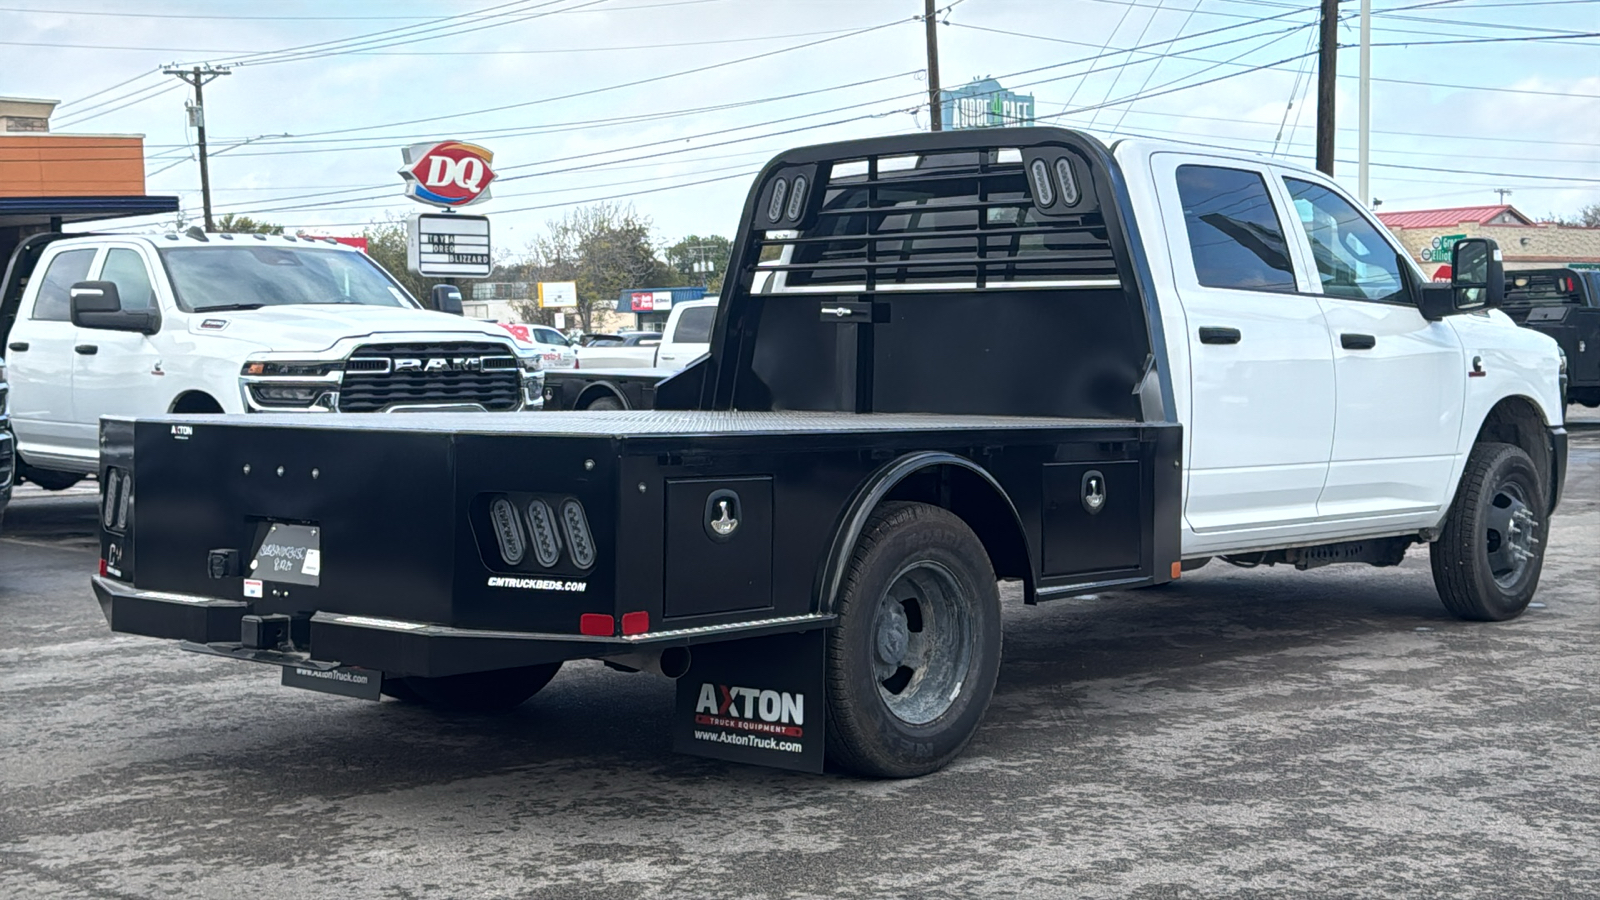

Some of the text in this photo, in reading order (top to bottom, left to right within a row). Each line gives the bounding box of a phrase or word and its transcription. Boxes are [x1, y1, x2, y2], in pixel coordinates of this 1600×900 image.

[425, 155, 484, 193] DQ
[428, 234, 444, 243] TRY
[433, 244, 455, 253] OREO
[449, 254, 489, 264] BLIZZARD
[394, 358, 480, 372] RAM
[170, 425, 193, 435] AXTON
[487, 576, 587, 592] CMTRUCKBEDS.COM
[695, 683, 804, 725] AXTON
[710, 717, 786, 733] TRUCK EQUIPMENT
[694, 730, 802, 752] www.AxtonTruck.com
